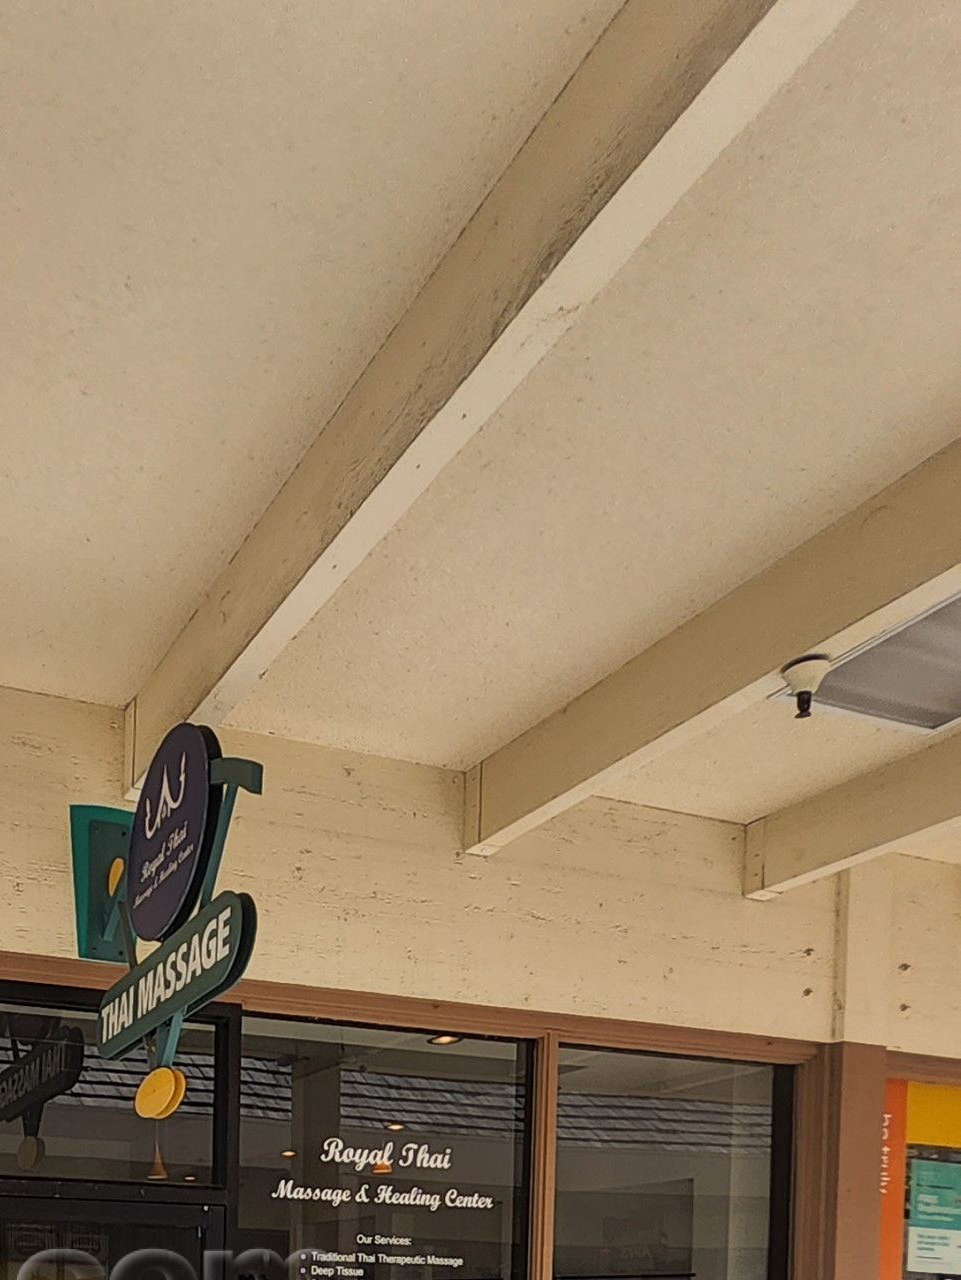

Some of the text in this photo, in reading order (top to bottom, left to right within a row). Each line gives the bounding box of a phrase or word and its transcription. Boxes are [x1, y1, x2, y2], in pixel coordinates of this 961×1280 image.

[140, 820, 188, 883] Royal Thai
[101, 906, 232, 1044] THAI MASSAGE
[320, 1137, 452, 1171] Royal Thai
[271, 1179, 494, 1211] Massage & Healing Center
[356, 1234, 413, 1246] Our Services:
[311, 1251, 464, 1268] Traditional Thai Therapeutic Massage
[311, 1266, 364, 1277] Deep Tissue
